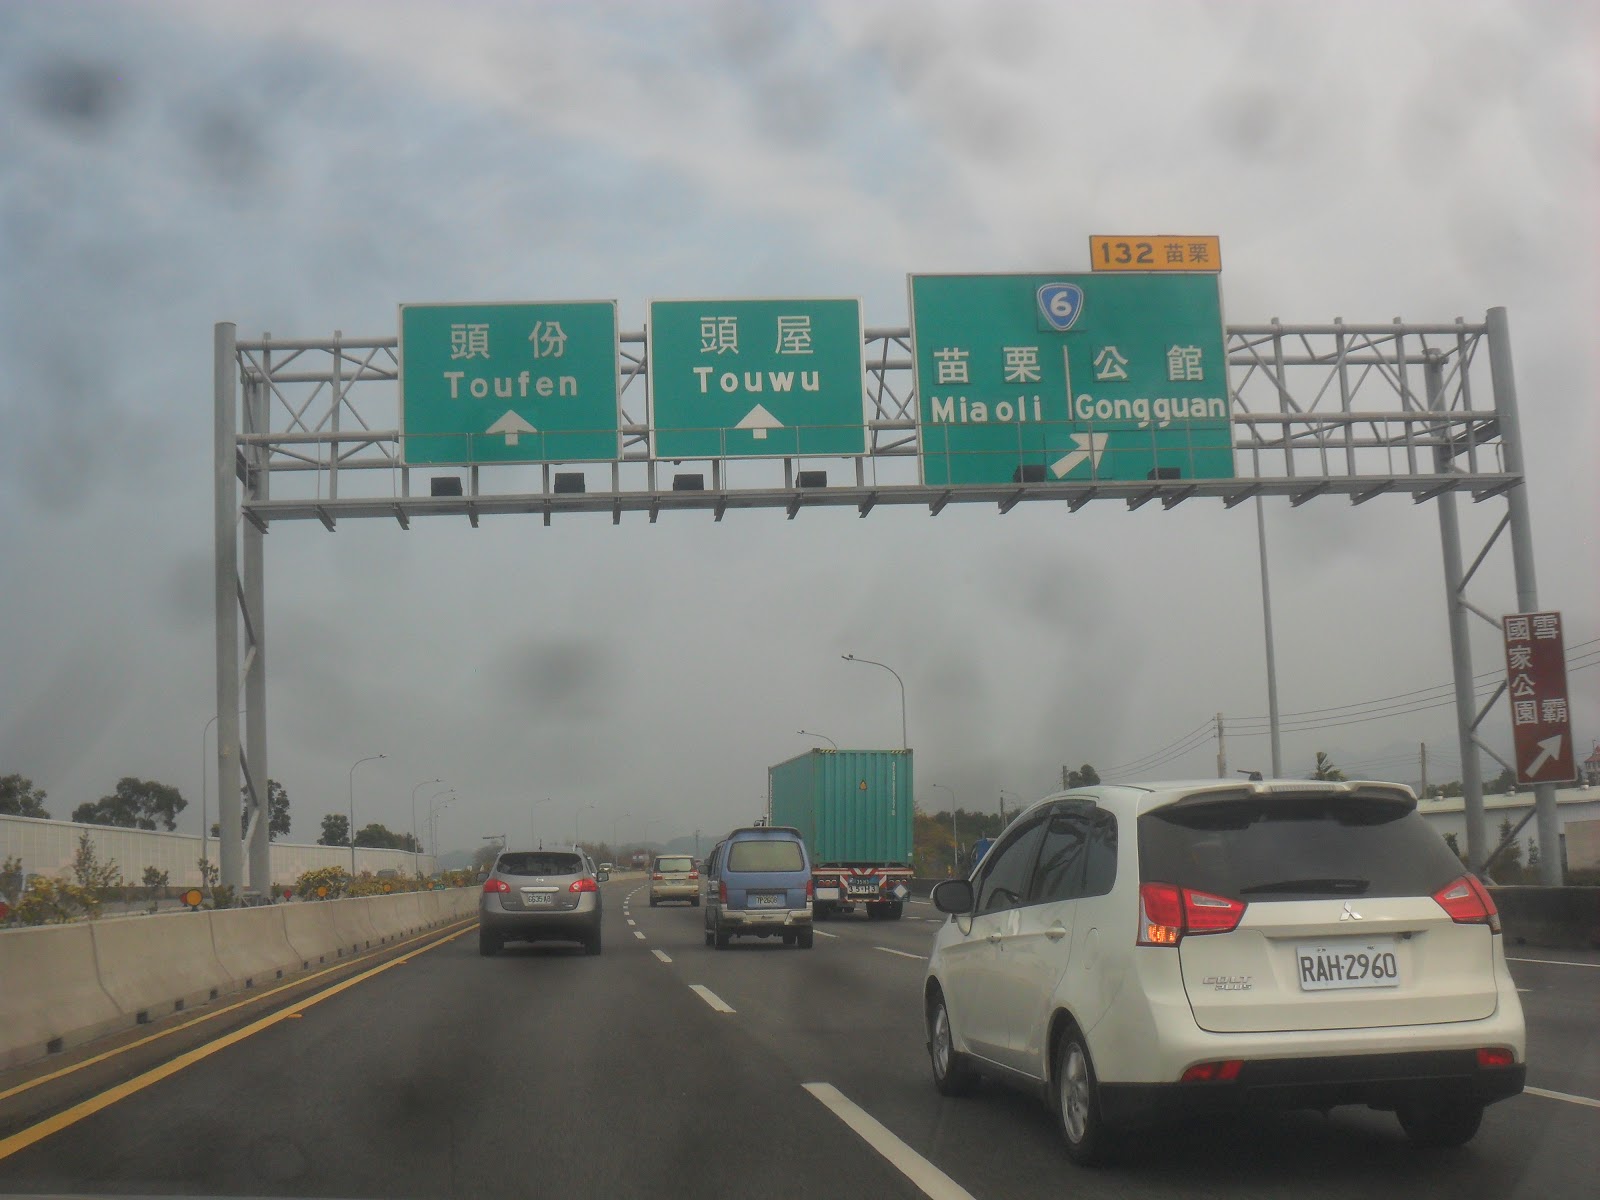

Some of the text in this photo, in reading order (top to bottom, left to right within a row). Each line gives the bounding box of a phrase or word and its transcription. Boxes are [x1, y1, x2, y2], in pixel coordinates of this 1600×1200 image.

[1101, 242, 1209, 264] 132 苗栗
[1050, 291, 1072, 317] 6
[450, 320, 568, 360] 頭份
[699, 315, 814, 355] 頭屋
[693, 366, 820, 393] Touwu
[934, 346, 1041, 384] 苗栗
[1093, 345, 1204, 381] 公館
[443, 371, 578, 399] Toufen
[931, 395, 1042, 423] Miaoli
[1075, 393, 1226, 428] Gongguan
[1505, 617, 1539, 725] 國家公園
